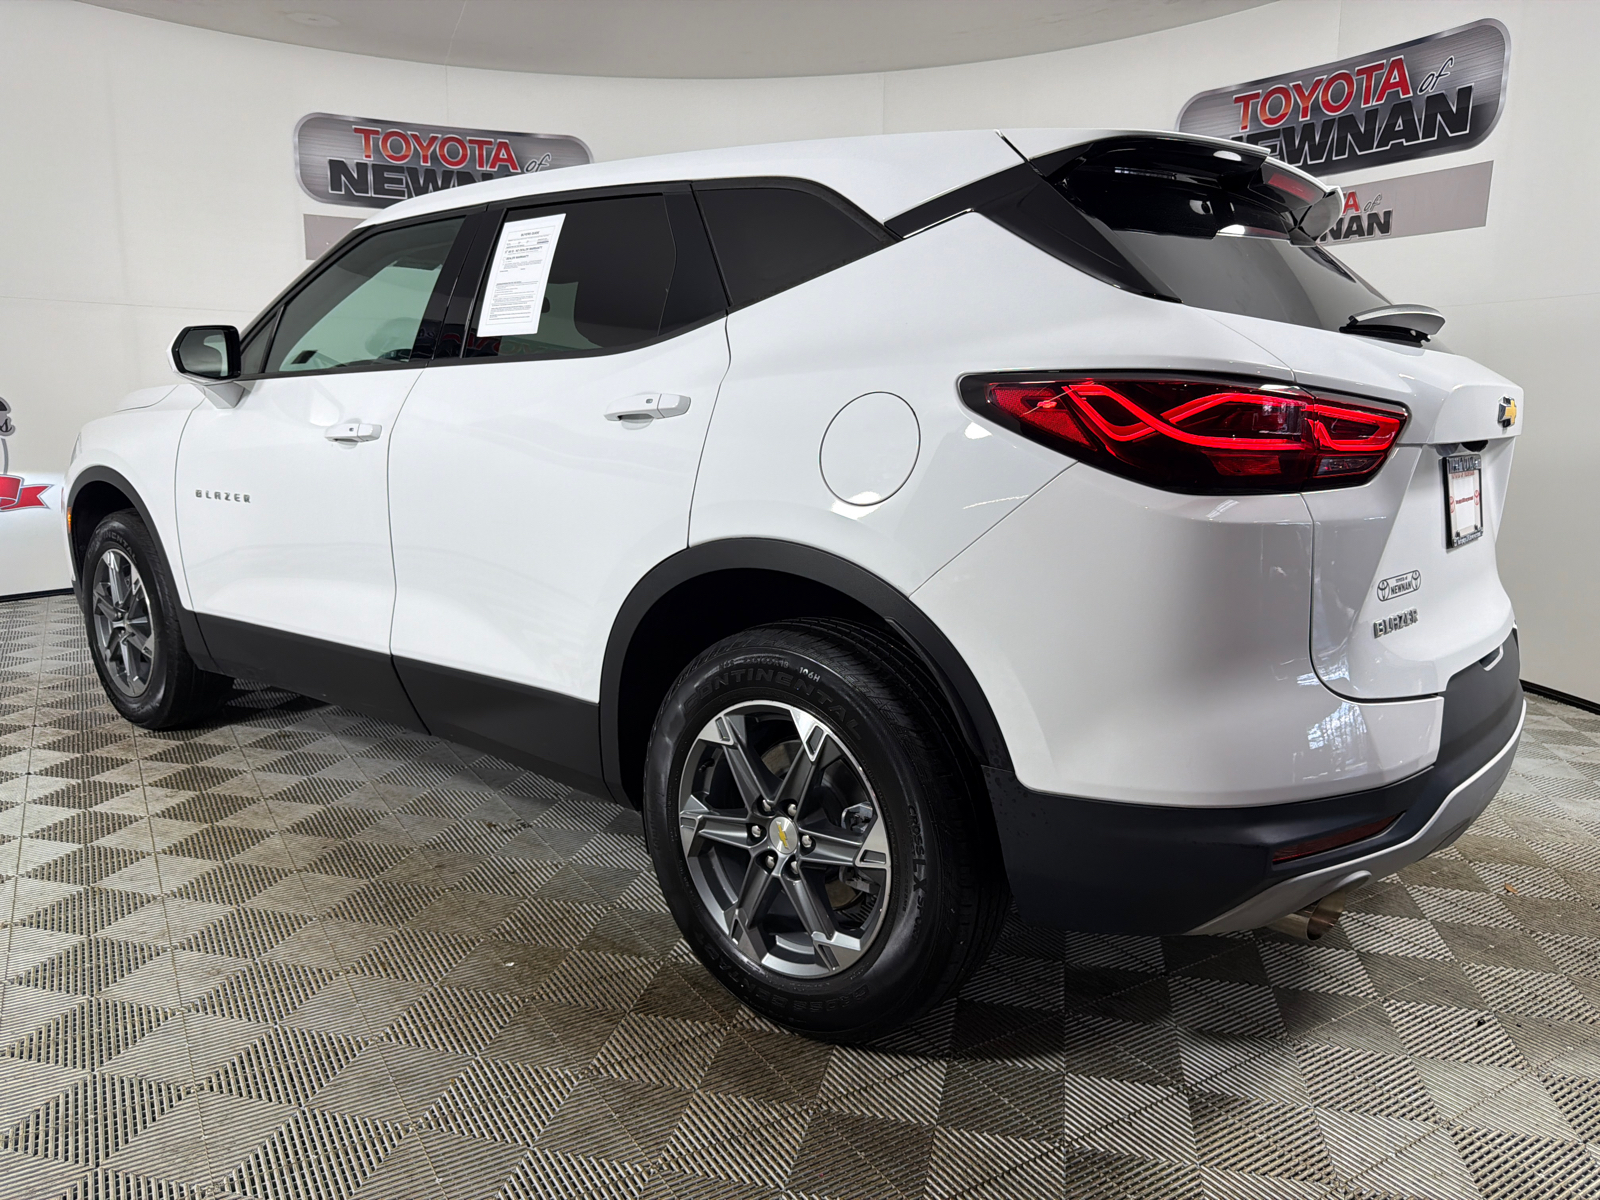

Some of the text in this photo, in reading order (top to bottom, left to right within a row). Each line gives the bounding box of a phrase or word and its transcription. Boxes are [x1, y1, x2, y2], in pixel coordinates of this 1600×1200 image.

[1232, 55, 1455, 132] TOYOTA of
[1231, 83, 1474, 167] EWNAN
[353, 125, 551, 173] TOYOTA of
[327, 158, 508, 199] NEW
[1364, 193, 1382, 213] of
[195, 489, 251, 504] BLAZER
[1390, 581, 1412, 595] NEWNAN
[1373, 607, 1419, 639] BLAZER
[798, 665, 821, 683] 106H
[683, 667, 863, 741] CONTINENTAL
[907, 804, 925, 856] CROSS
[912, 858, 928, 894] LX
